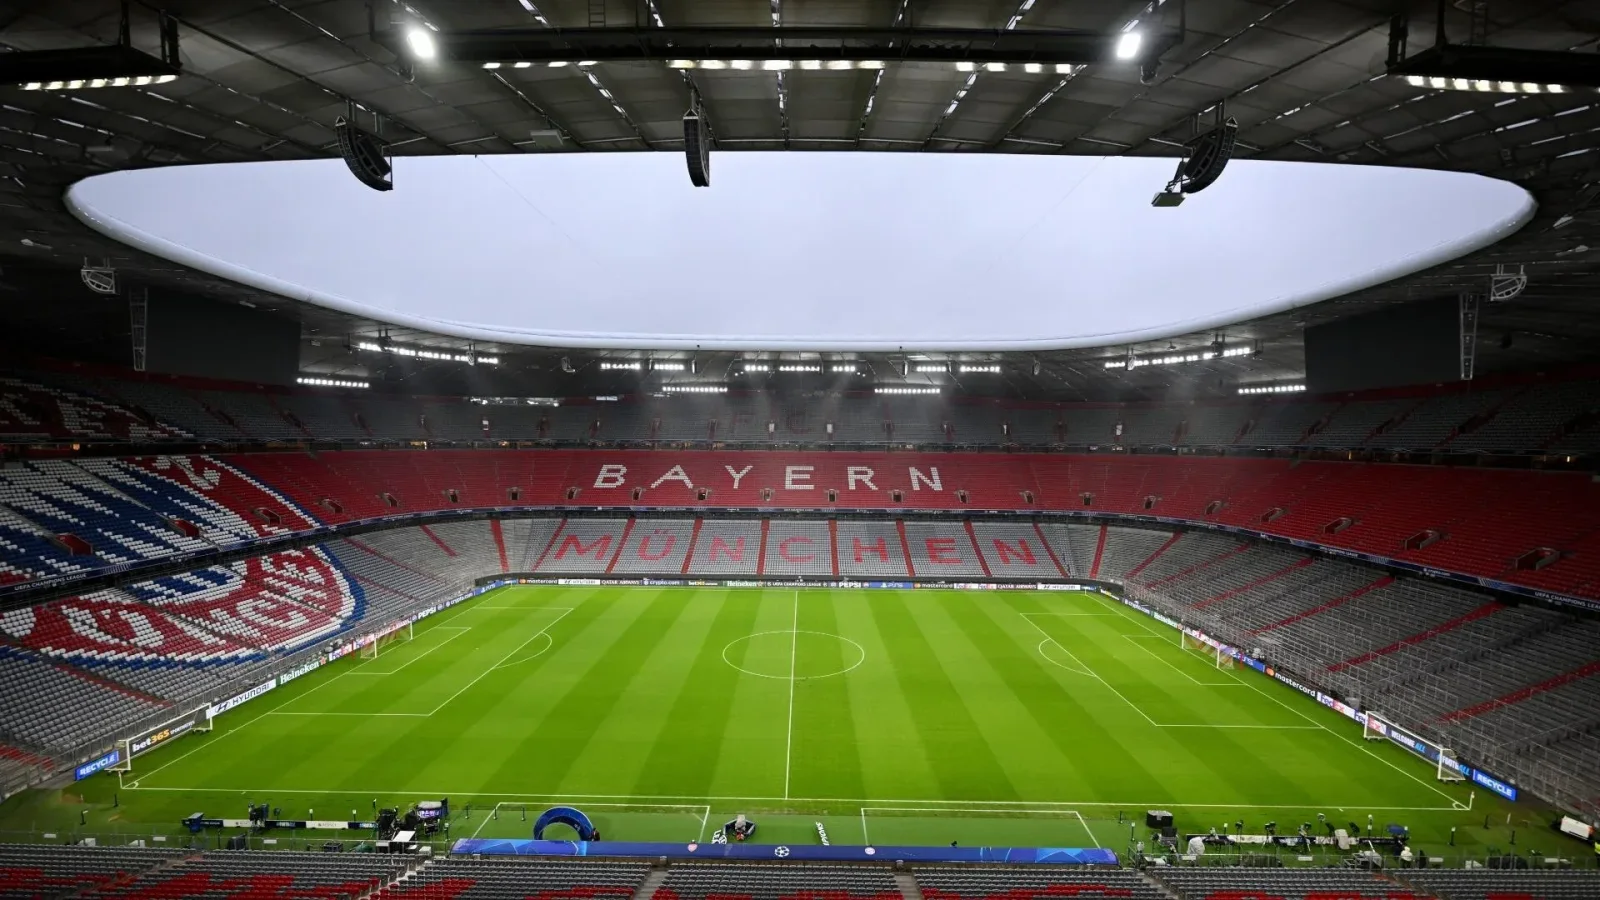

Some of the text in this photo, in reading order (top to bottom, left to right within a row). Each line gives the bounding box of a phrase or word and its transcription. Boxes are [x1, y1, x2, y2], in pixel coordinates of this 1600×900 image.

[593, 463, 943, 491] BAYERN
[553, 528, 1038, 566] MÜNCHEN
[14, 572, 88, 591] UEFA CHAMPIONS LEAGUE
[1534, 591, 1551, 599] UEFA
[1550, 594, 1586, 607] CHAMPIONS
[417, 606, 437, 619] PEPSI
[279, 660, 320, 685] Heineken
[1275, 672, 1316, 697] mastercard
[232, 683, 270, 706] HYUNDAI
[132, 728, 171, 753] bet365
[1391, 729, 1426, 753] WELCOME ALL
[79, 754, 115, 777] RECYCLE
[1477, 773, 1513, 798] RECYCLE
